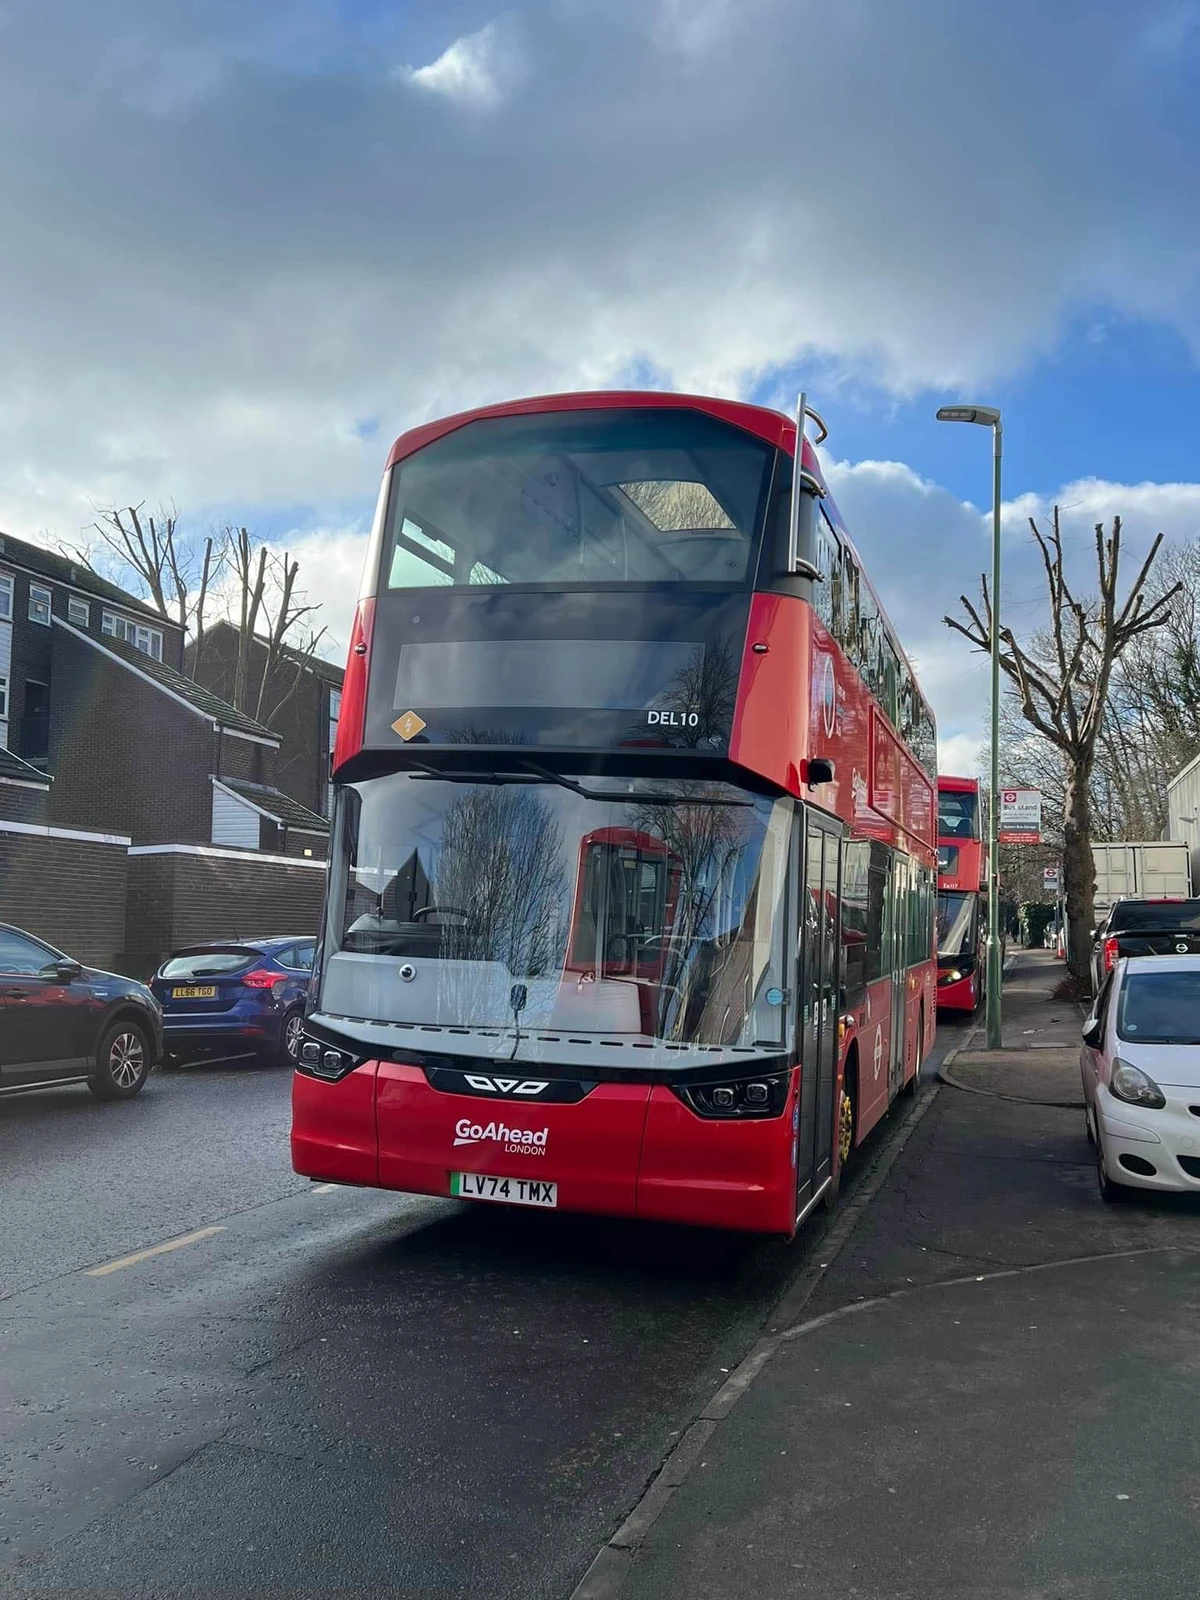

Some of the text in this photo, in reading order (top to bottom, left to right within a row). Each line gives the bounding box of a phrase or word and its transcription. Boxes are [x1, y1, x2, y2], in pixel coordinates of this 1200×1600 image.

[647, 711, 699, 727] DEL10
[455, 1118, 549, 1146] GoAhead
[504, 1143, 546, 1156] LONDON
[463, 1174, 553, 1203] LV74 TMX
